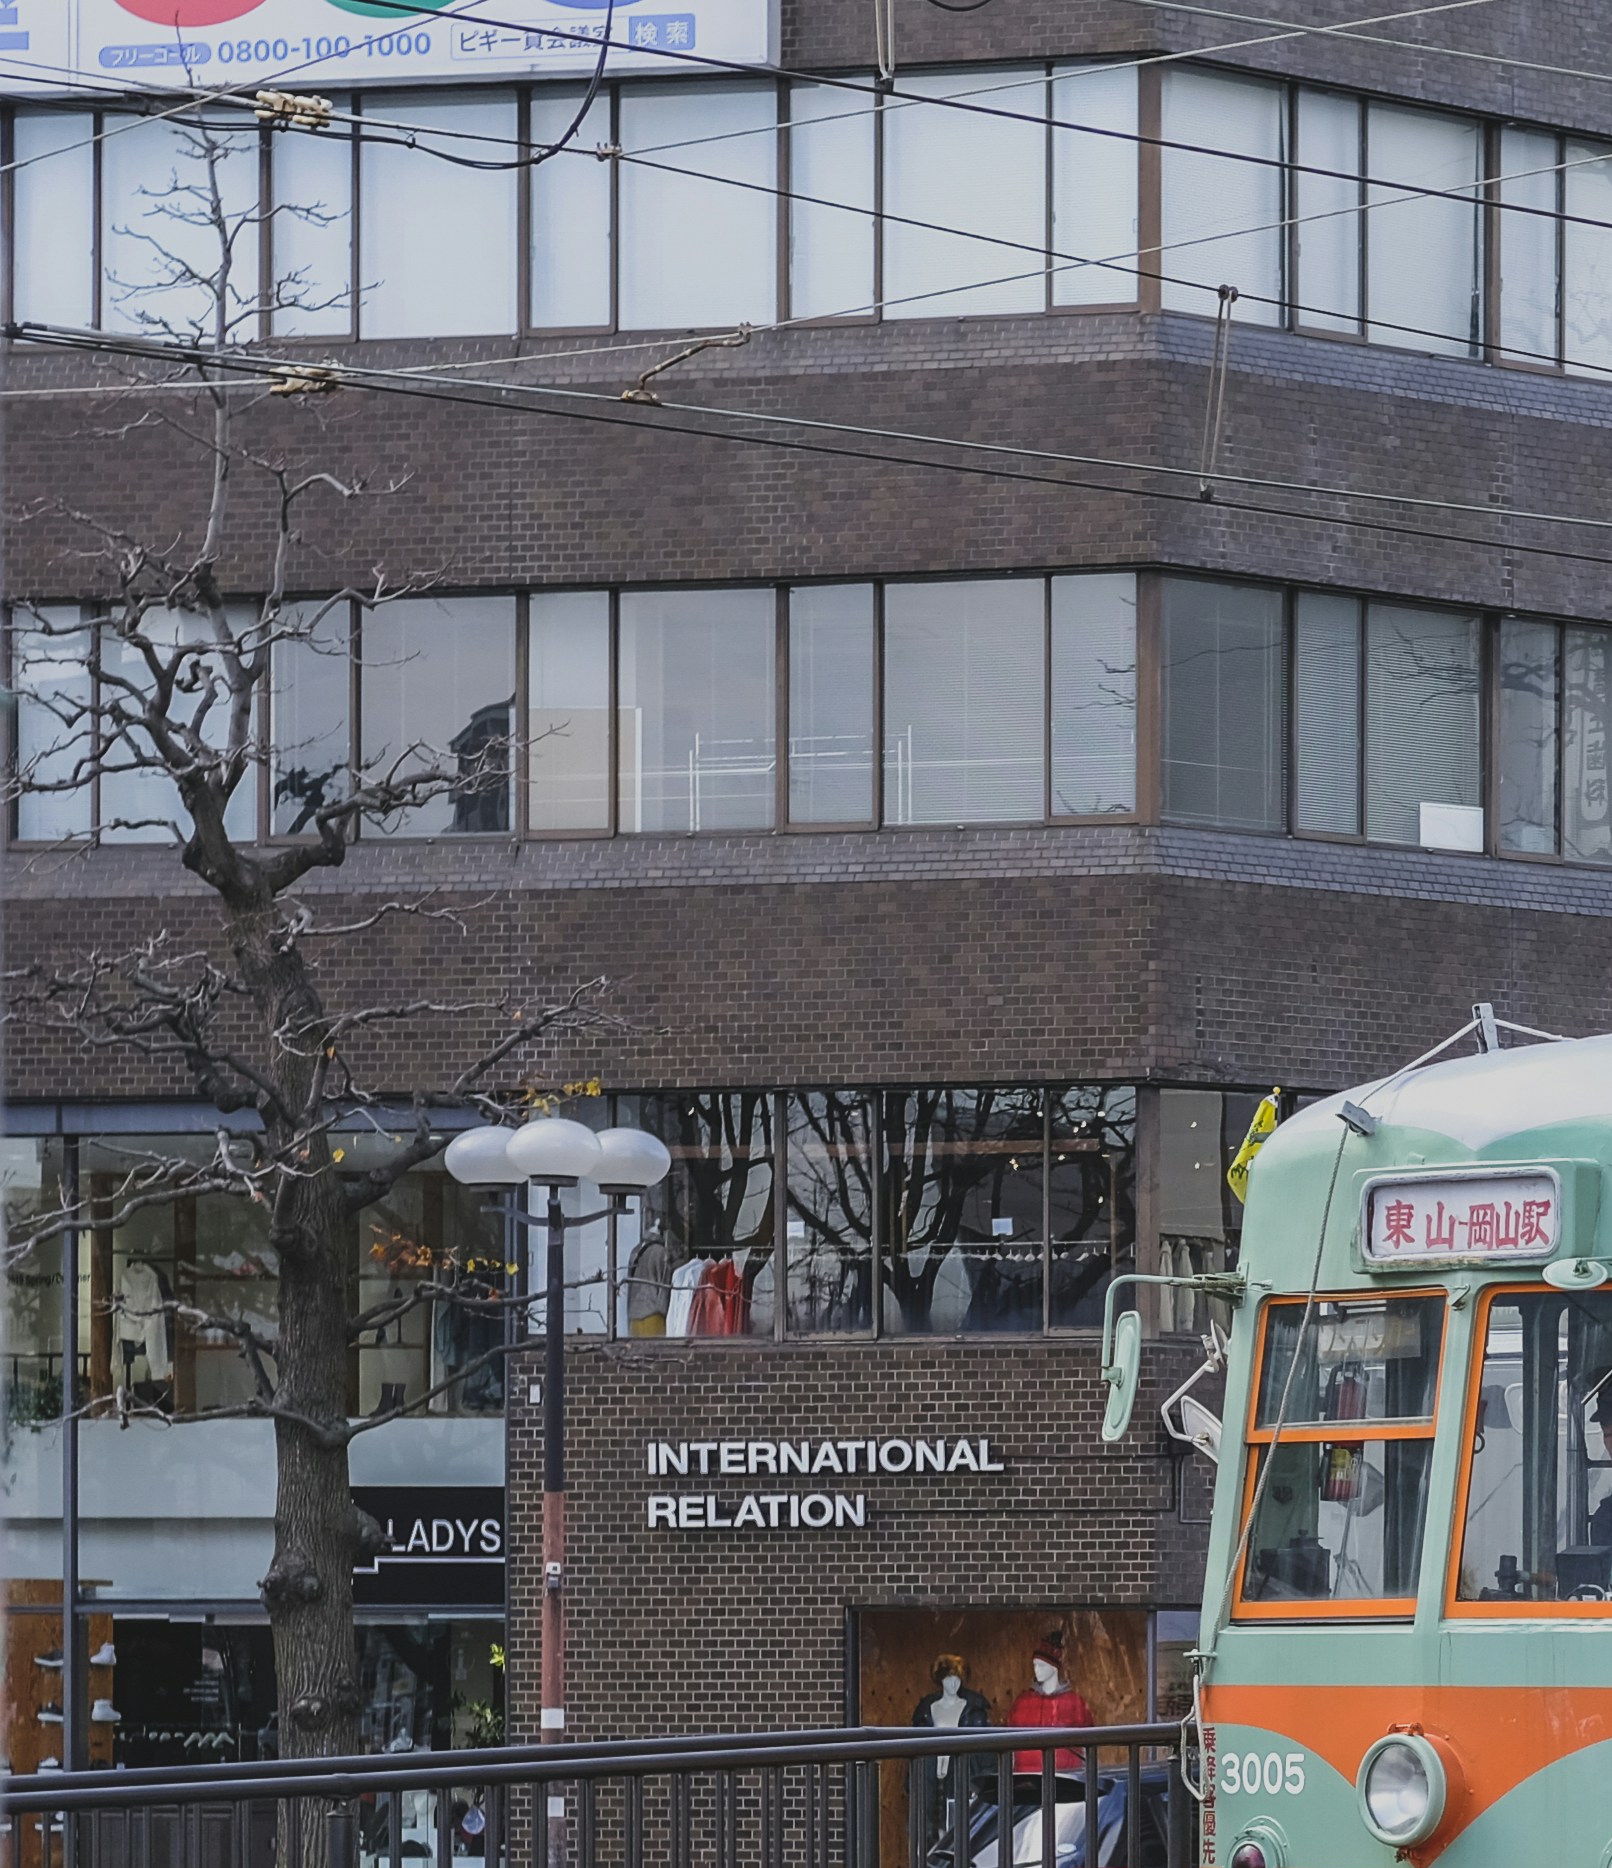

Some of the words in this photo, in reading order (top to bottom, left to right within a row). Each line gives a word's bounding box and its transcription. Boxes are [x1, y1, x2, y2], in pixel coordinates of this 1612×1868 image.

[647, 1438, 1005, 1475] INTERNATIONAL
[647, 1493, 866, 1528] RELATION
[1220, 1752, 1306, 1795] 3005
